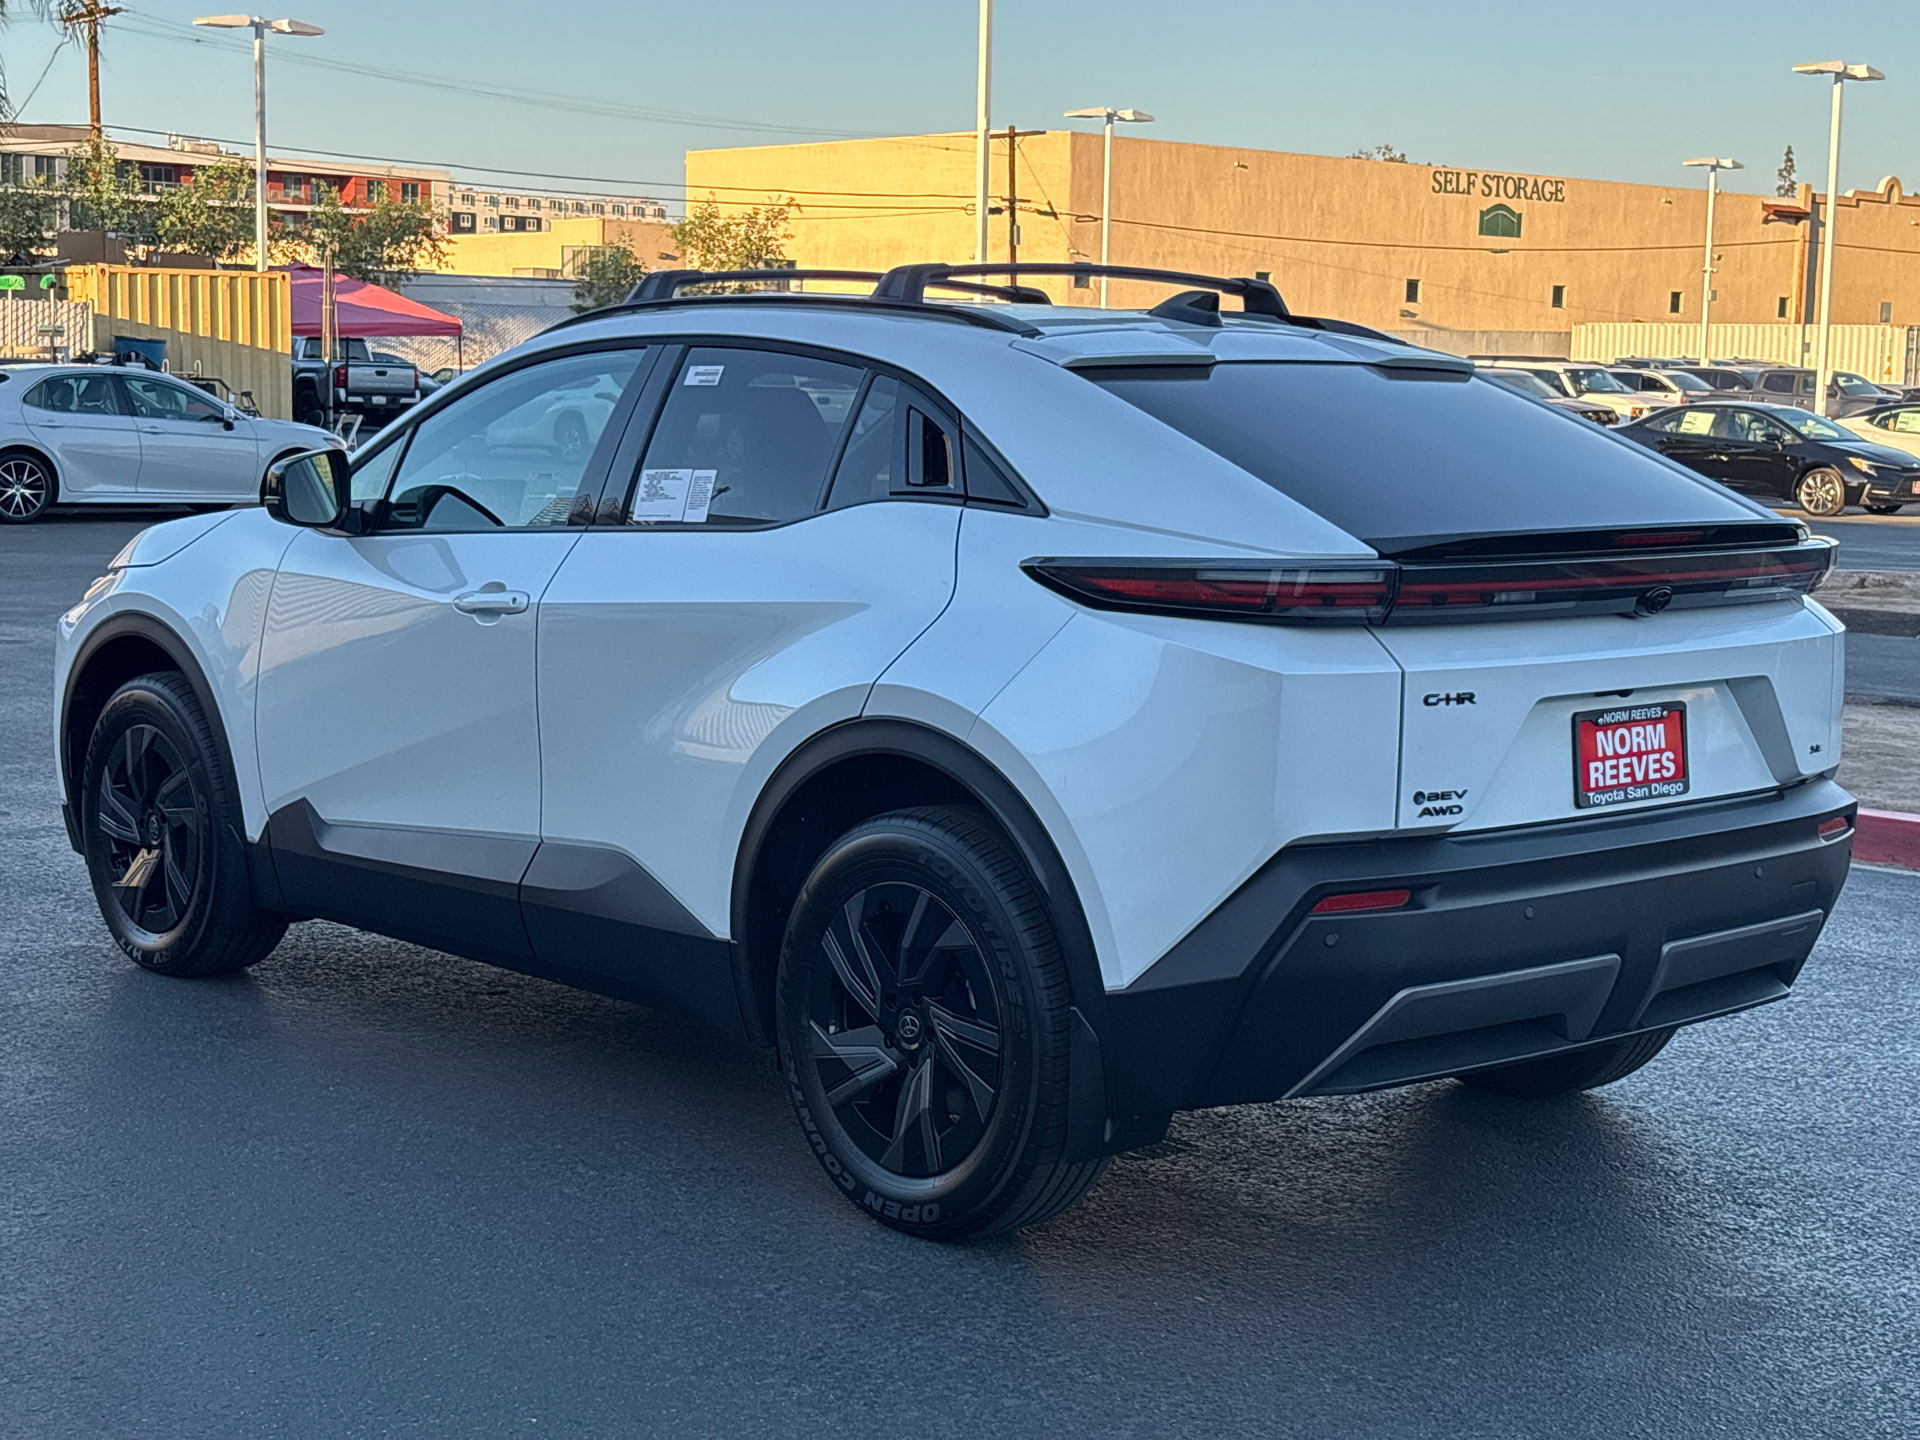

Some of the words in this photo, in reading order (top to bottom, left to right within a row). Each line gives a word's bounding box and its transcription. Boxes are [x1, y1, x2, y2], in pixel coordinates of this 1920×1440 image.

[1432, 170, 1478, 195] SELF
[1481, 174, 1565, 203] STORAGE
[1423, 691, 1477, 706] C-HR
[1603, 710, 1629, 724] NORM
[1631, 707, 1662, 720] REEVES
[1596, 723, 1666, 757] NORM
[1589, 751, 1676, 788] REEVES
[1587, 790, 1625, 805] Toyota
[1627, 786, 1649, 799] San
[1651, 782, 1684, 796] Diego
[1417, 804, 1463, 818] AWD
[917, 846, 987, 912] TOYO
[981, 914, 1028, 1033] TIRES
[863, 1190, 941, 1223] OPEN
